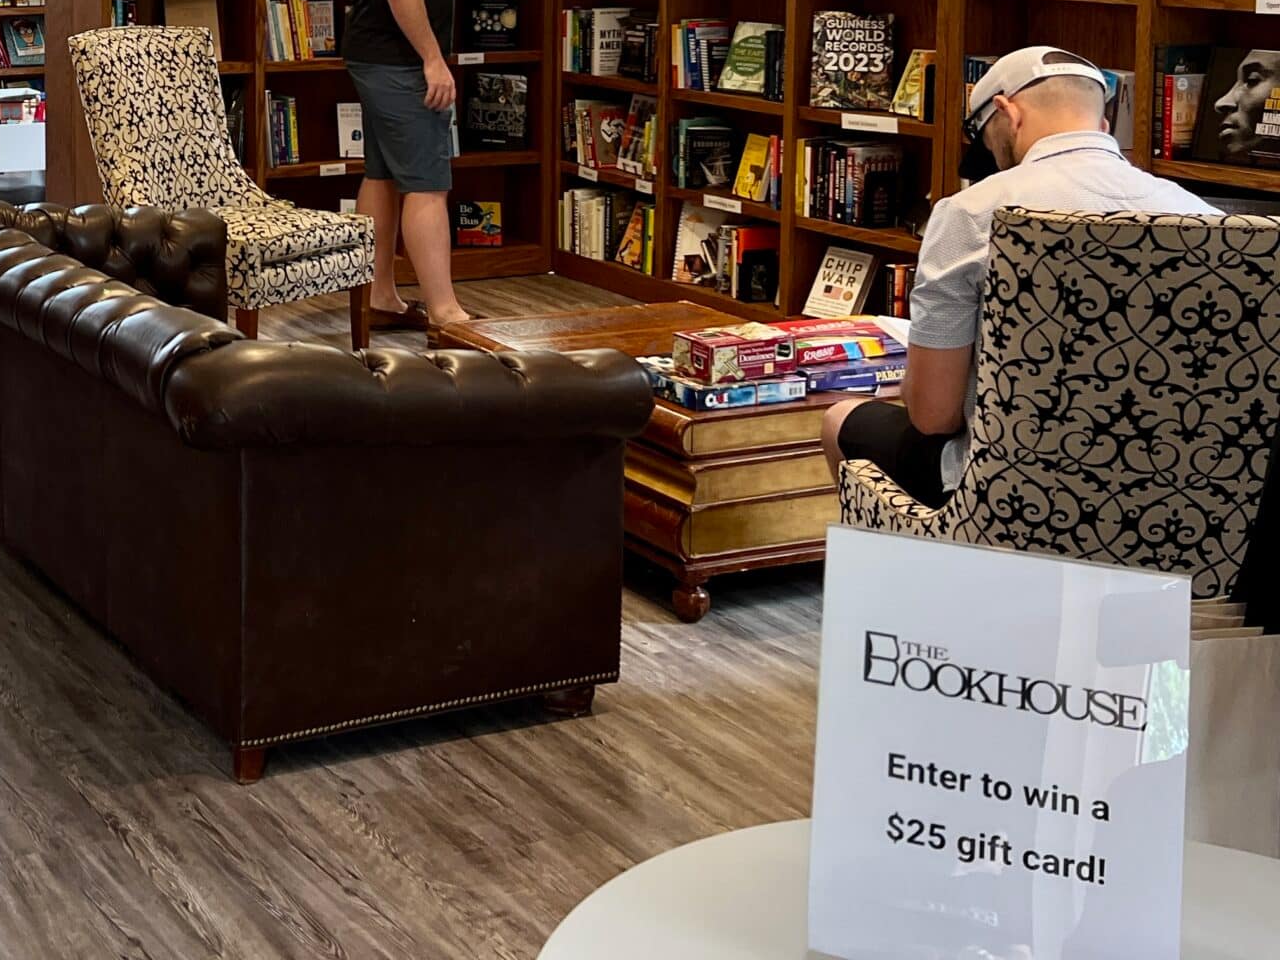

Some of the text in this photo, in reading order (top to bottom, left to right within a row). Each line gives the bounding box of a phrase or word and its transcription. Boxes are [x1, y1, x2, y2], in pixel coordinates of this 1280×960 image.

[826, 20, 885, 30] GUINNESS
[826, 29, 885, 42] WORLD
[825, 41, 885, 53] RECORDS
[824, 52, 884, 72] 2023
[824, 257, 863, 273] CHIP
[822, 270, 856, 288] WAR
[901, 640, 951, 662] THE
[863, 630, 1149, 732] BOOKHOUSE
[887, 752, 1110, 821] Enter to win a
[886, 810, 1106, 885] $25 gift card!
